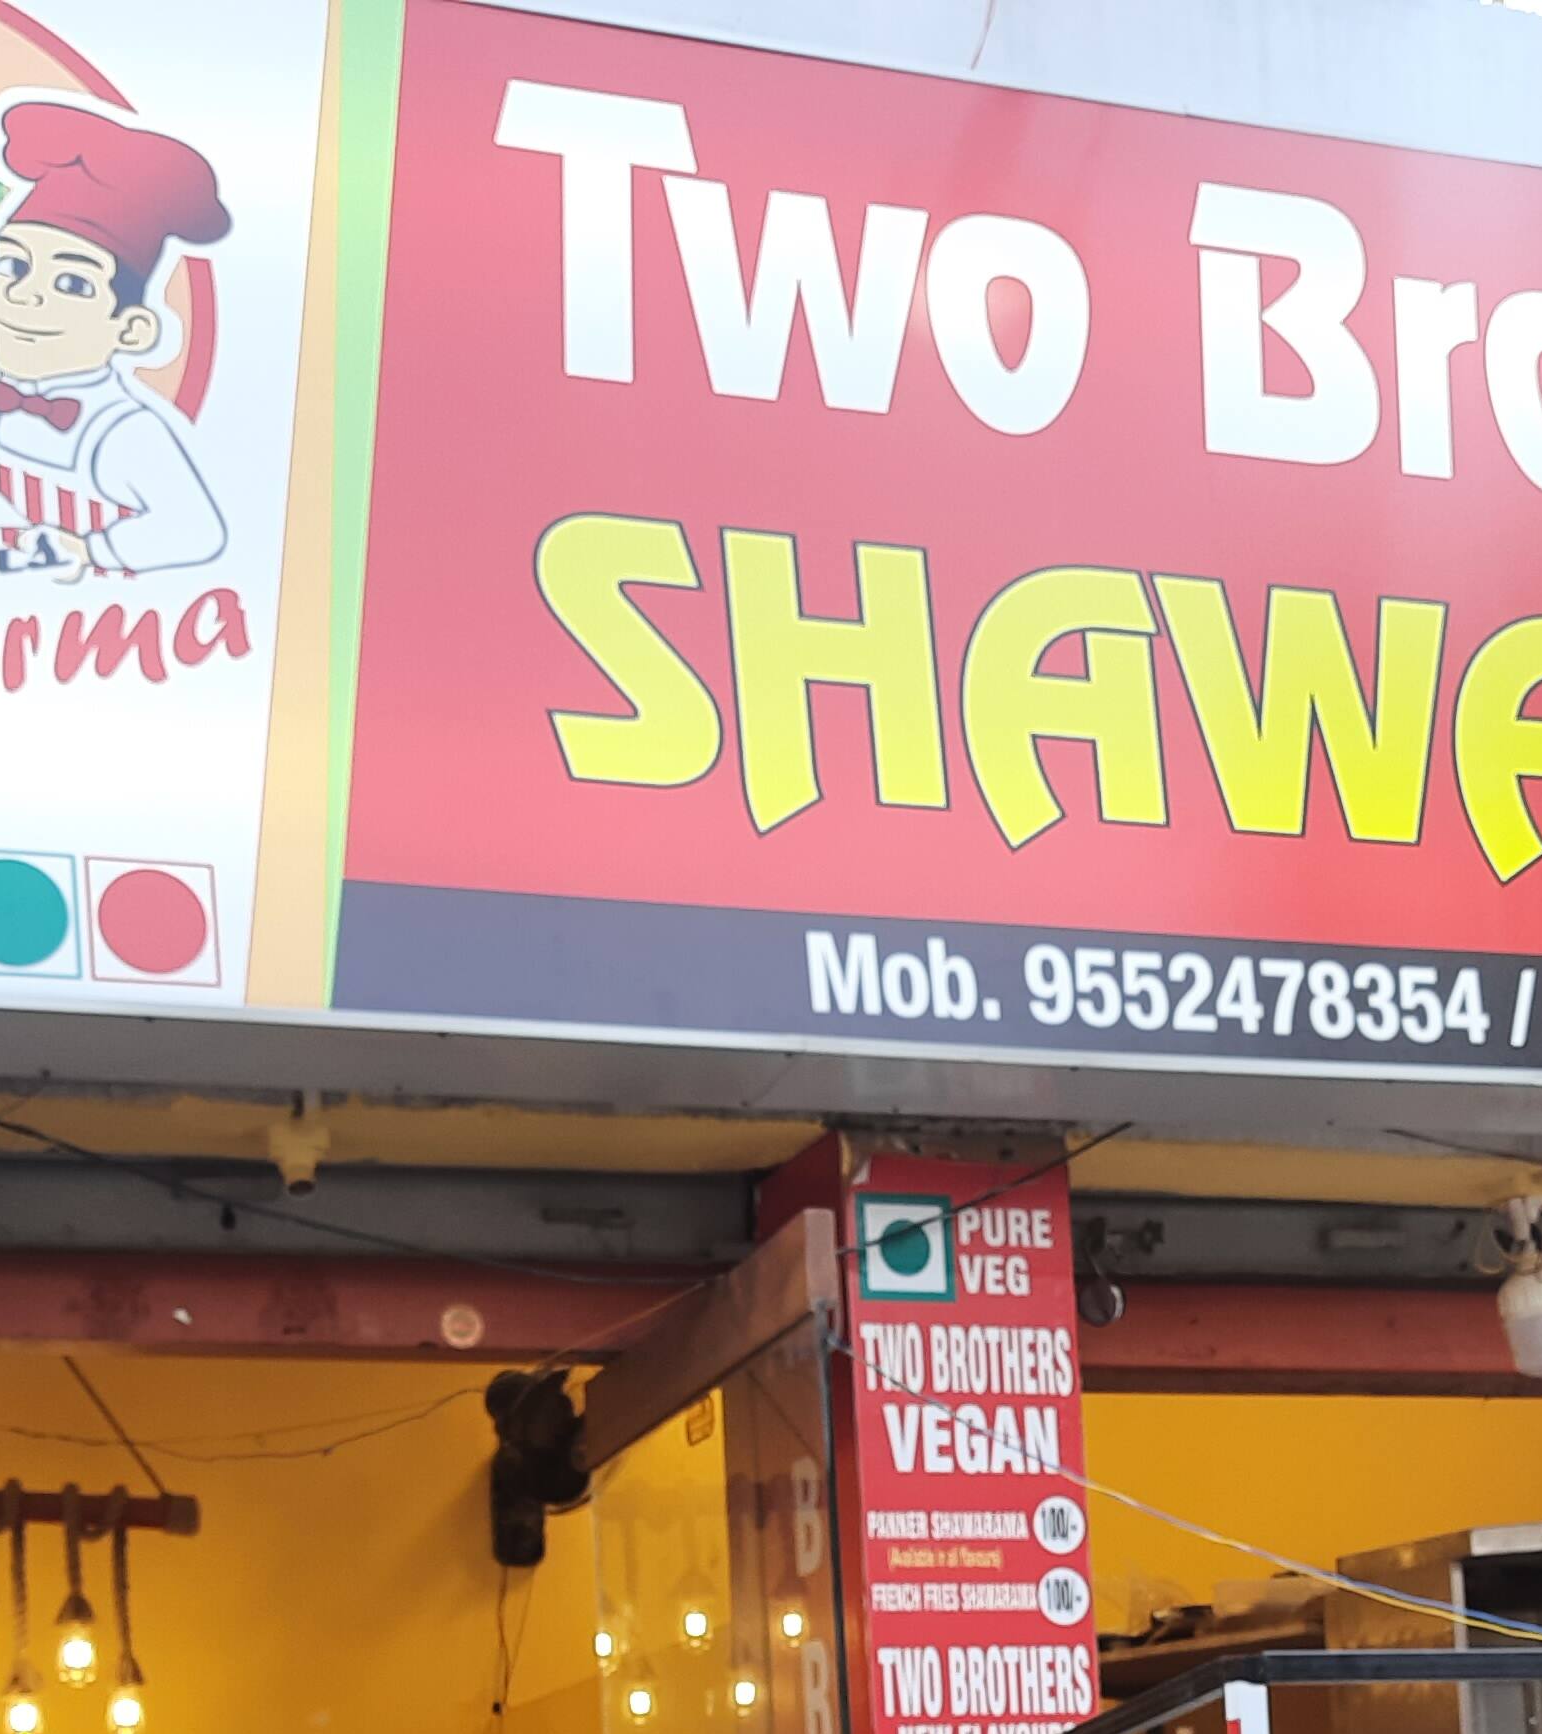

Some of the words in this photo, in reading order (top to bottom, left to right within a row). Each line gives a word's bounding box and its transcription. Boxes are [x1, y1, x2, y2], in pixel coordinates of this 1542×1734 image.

[492, 77, 1091, 438] Two
[804, 930, 1002, 1023] Mob.
[1025, 943, 1489, 1046] 9552478354
[1510, 970, 1539, 1047] /
[958, 1207, 1053, 1249] PURE
[959, 1254, 1030, 1297] VEG
[859, 1322, 925, 1393] TWO
[929, 1323, 1074, 1397] BROTHERS
[882, 1403, 1061, 1475] VEGAN
[877, 1646, 943, 1718] TWO
[947, 1644, 1093, 1717] BROTHERS
